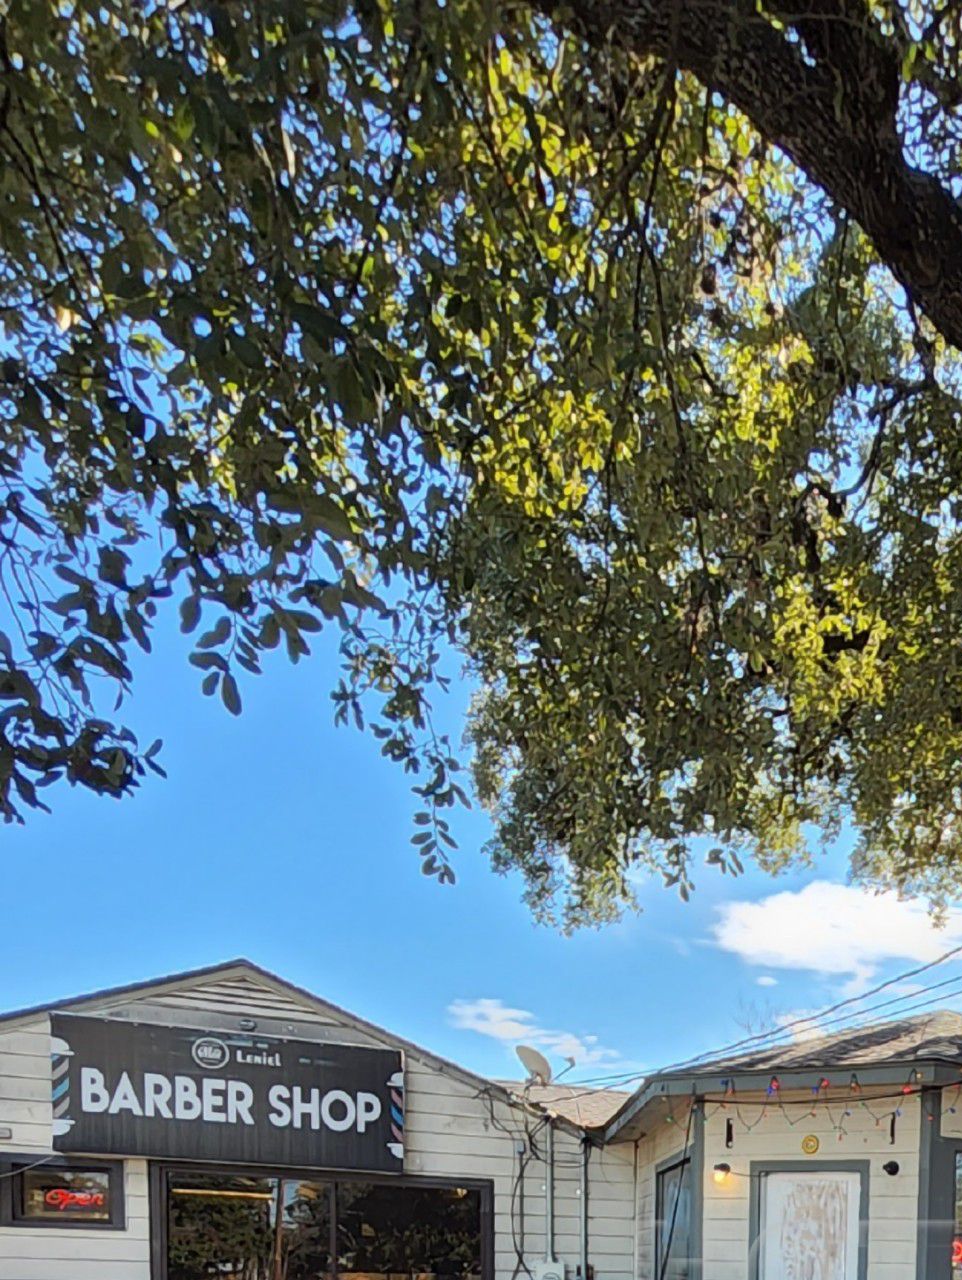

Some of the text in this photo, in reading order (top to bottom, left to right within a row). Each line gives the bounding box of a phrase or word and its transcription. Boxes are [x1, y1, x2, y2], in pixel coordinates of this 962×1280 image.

[81, 1067, 382, 1133] BARBER SHOP
[45, 1189, 105, 1210] Open
